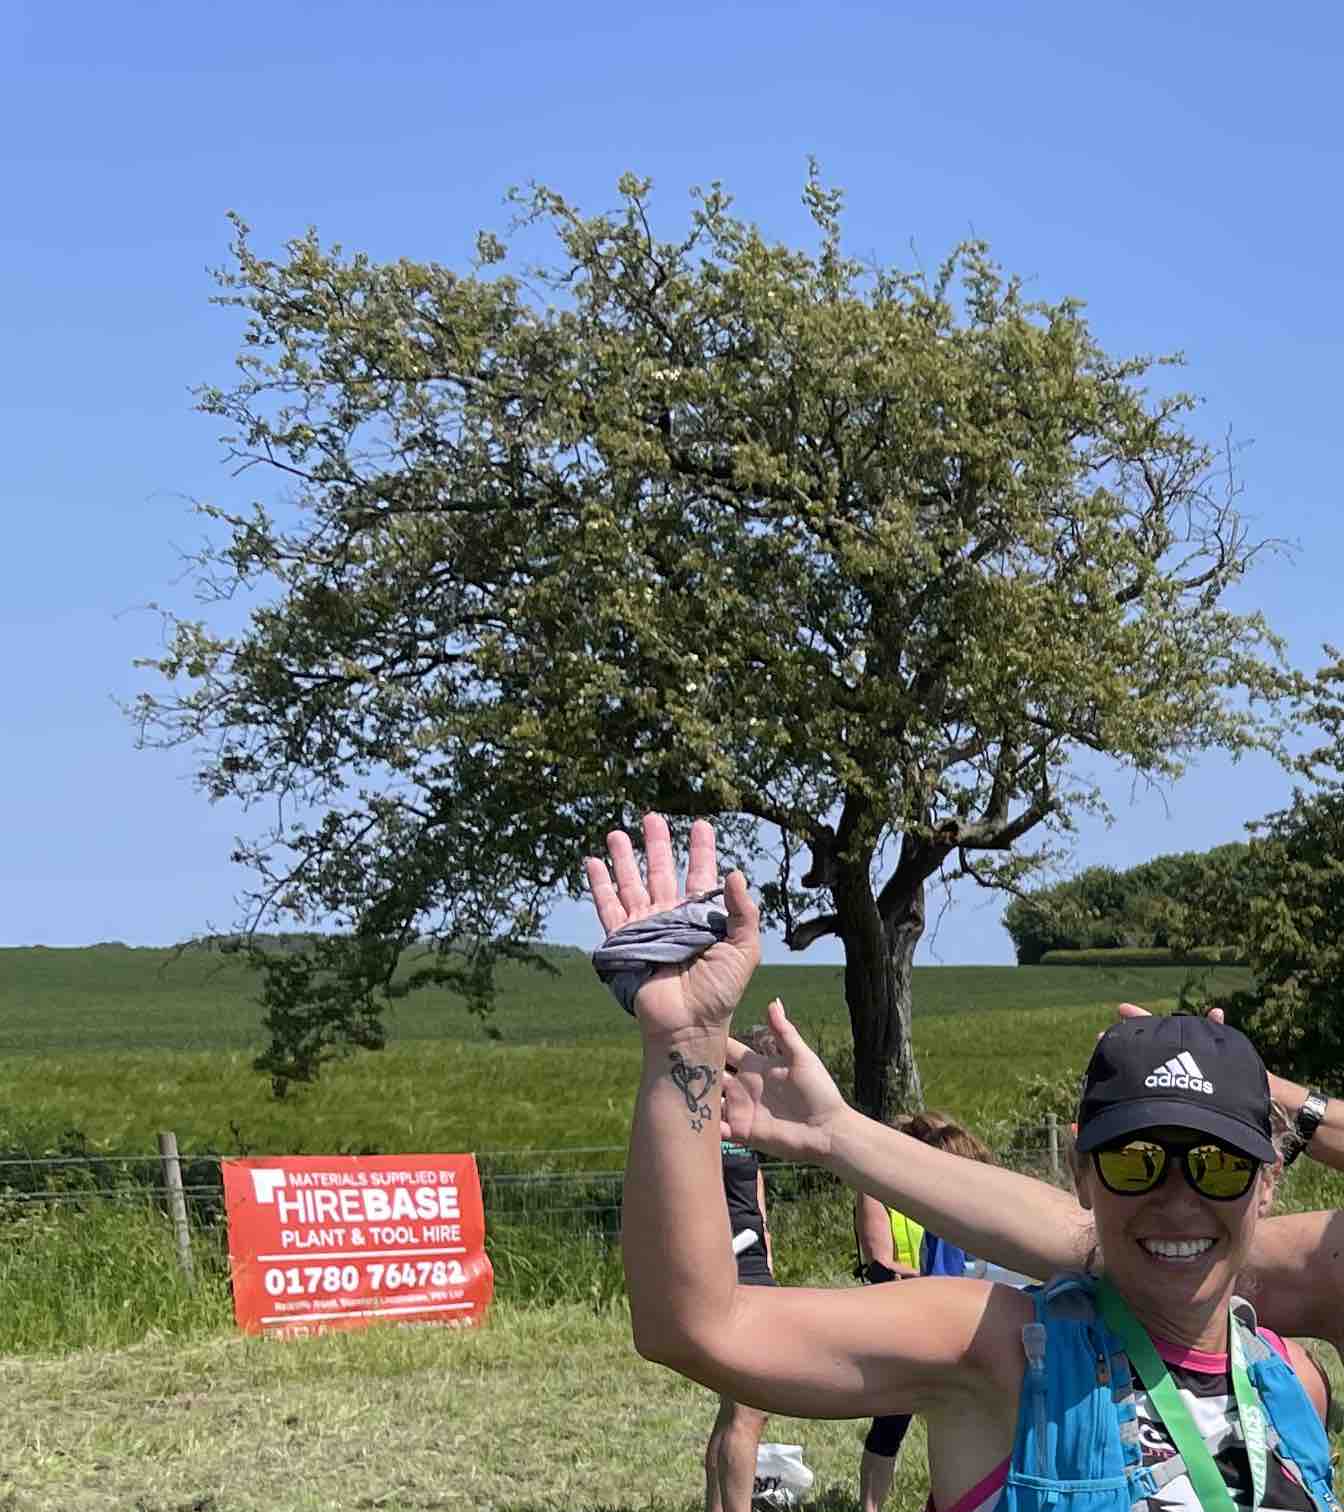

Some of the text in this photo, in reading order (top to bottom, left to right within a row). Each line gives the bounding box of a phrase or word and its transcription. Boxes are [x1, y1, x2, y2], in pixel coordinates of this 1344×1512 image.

[1144, 1072, 1214, 1094] adidas
[289, 1171, 456, 1187] MATERIALS SUPPLIED BY
[278, 1187, 460, 1223] HIREBASE
[281, 1224, 461, 1248] PLANT & TOOL HIRE
[265, 1260, 467, 1295] 01780 764782
